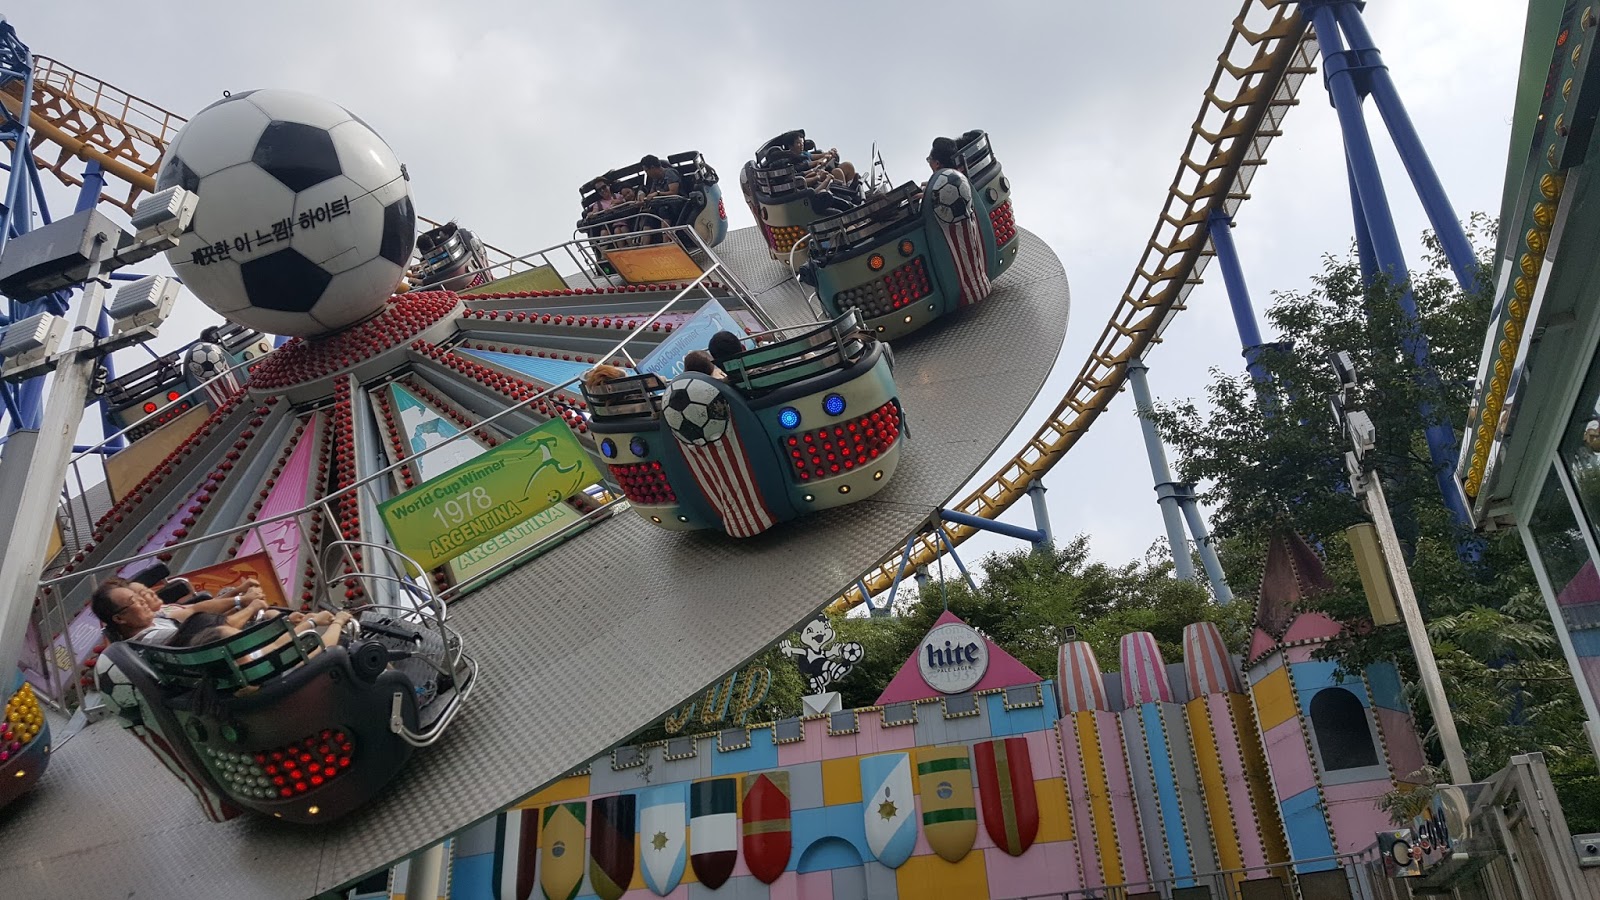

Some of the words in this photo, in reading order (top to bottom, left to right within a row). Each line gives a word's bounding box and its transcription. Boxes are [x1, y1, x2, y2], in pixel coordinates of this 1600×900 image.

[256, 217, 294, 246] 느낌!
[299, 195, 350, 229] 하이트!
[665, 348, 680, 360] Cup
[675, 329, 699, 350] Winner
[392, 493, 434, 519] World
[433, 482, 461, 500] Cup
[459, 459, 505, 487] Winner
[433, 486, 492, 529] 1978
[429, 499, 522, 559] ARGENTINA
[458, 503, 565, 570] ARGENTINA
[925, 640, 979, 669] hite
